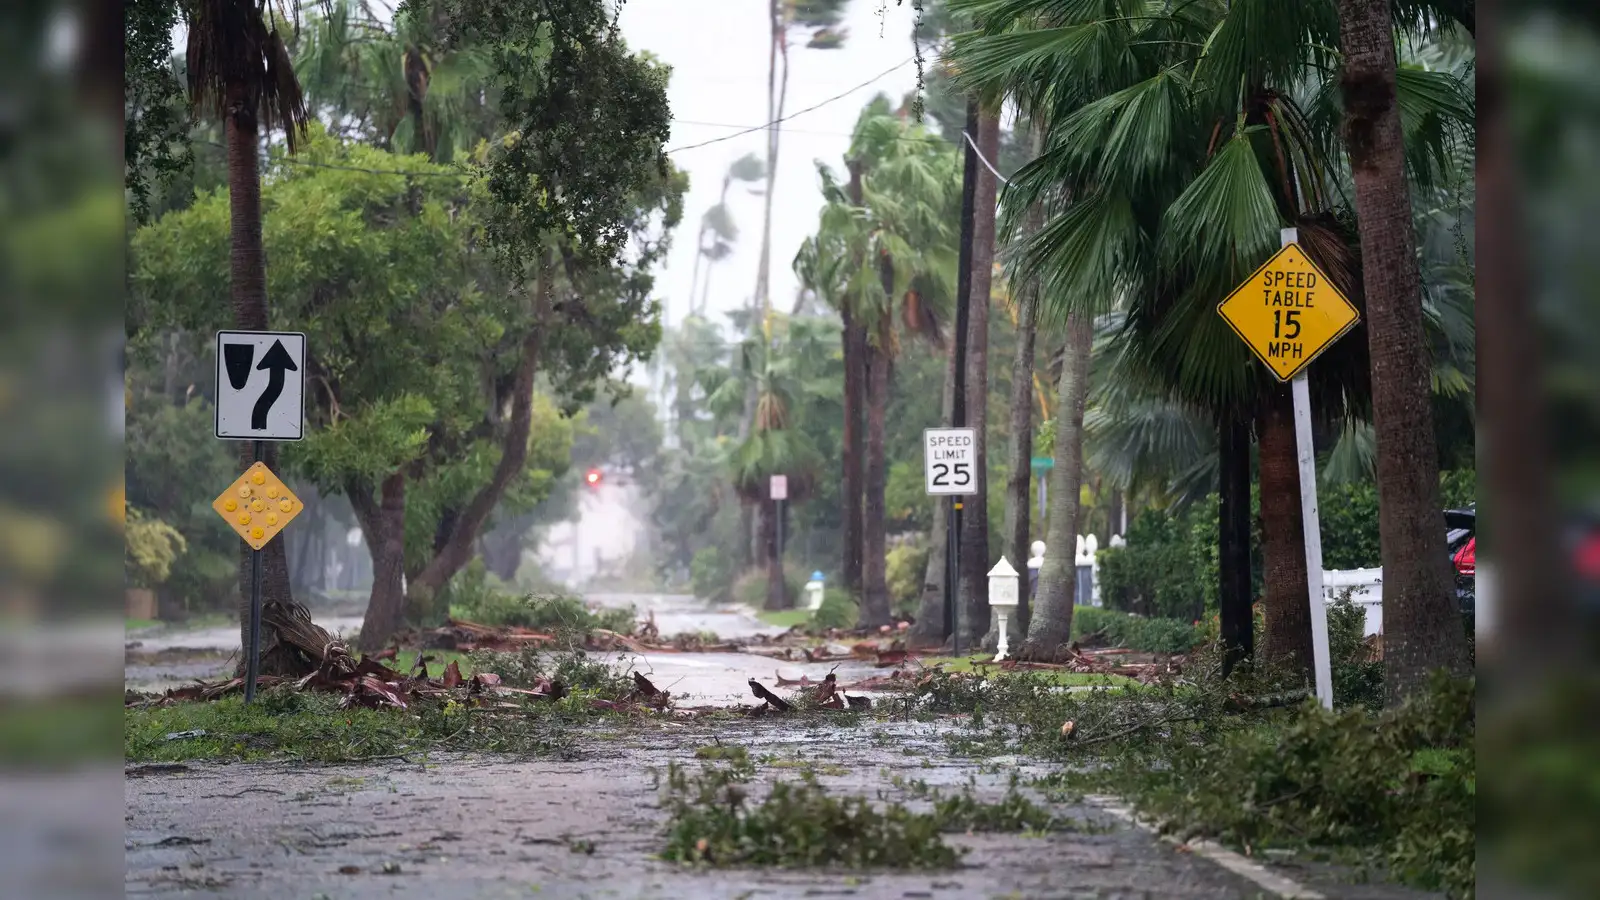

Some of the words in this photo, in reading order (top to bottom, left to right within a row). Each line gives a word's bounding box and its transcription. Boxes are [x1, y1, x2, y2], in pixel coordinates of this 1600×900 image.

[1263, 271, 1317, 288] SPEED
[1263, 290, 1315, 308] TABLE
[1273, 309, 1301, 340] 15
[1268, 342, 1303, 359] MPH
[930, 436, 971, 446] SPEED
[934, 450, 966, 460] LIMIT
[932, 463, 970, 486] 25
